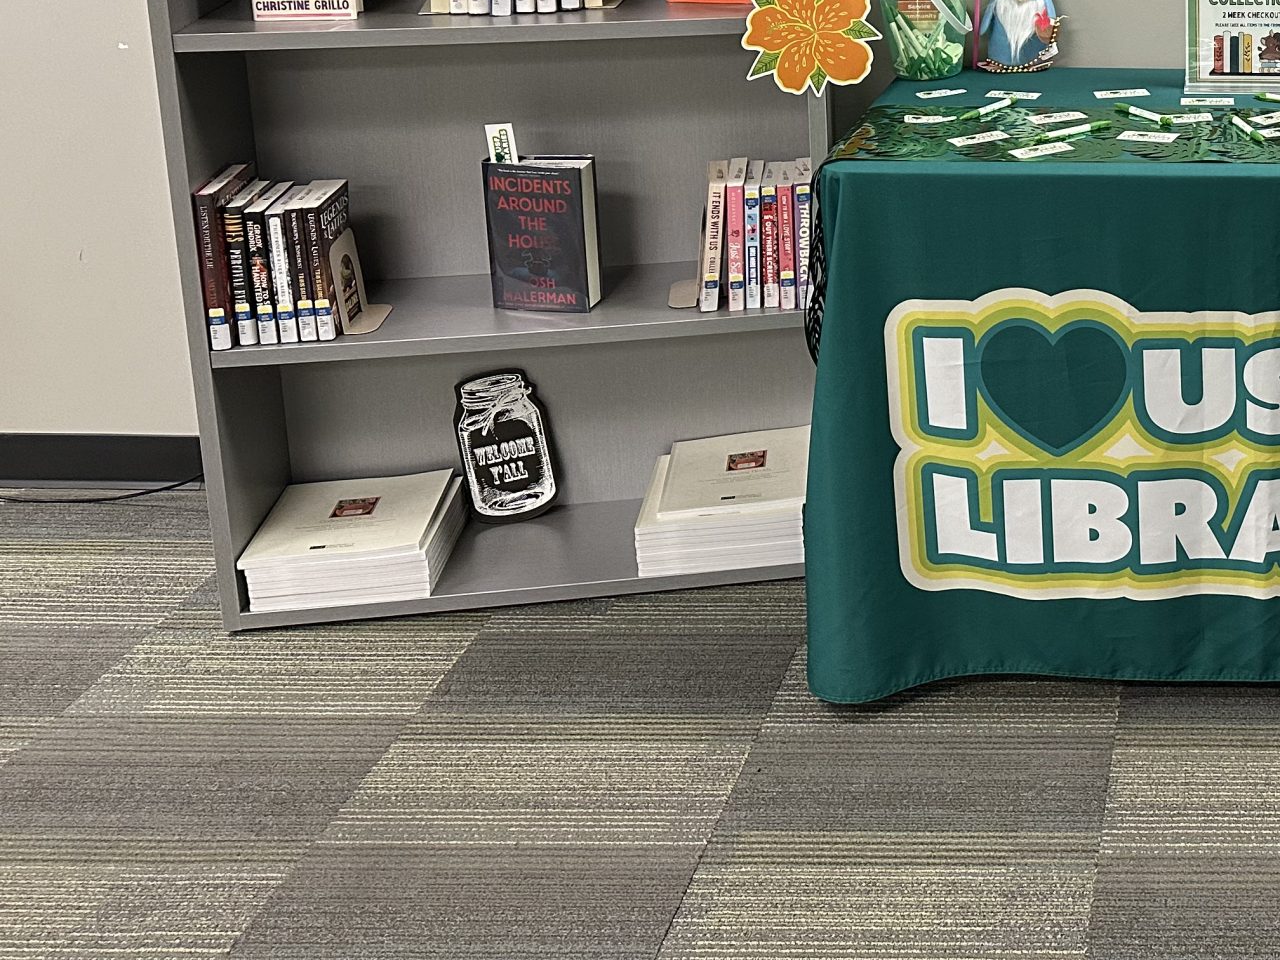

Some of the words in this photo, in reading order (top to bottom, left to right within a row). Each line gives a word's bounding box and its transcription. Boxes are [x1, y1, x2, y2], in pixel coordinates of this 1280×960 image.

[256, 0, 310, 11] CHRISTINE
[315, 0, 349, 10] GRILLO
[489, 176, 571, 195] INCIDENTS
[497, 196, 567, 213] AROUND
[711, 200, 720, 219] ENDS
[223, 213, 244, 243] JAMES
[519, 215, 547, 231] THE
[710, 220, 720, 239] WITH
[246, 221, 256, 252] HENDRIX
[254, 224, 263, 248] GRADY
[709, 241, 718, 251] US
[799, 203, 809, 281] THROWBACK
[230, 249, 245, 287] PERCIVAL
[503, 292, 576, 305] MALERMAN
[922, 336, 968, 431] I
[473, 436, 536, 466] WELCOME
[489, 461, 528, 485] Y'ALL
